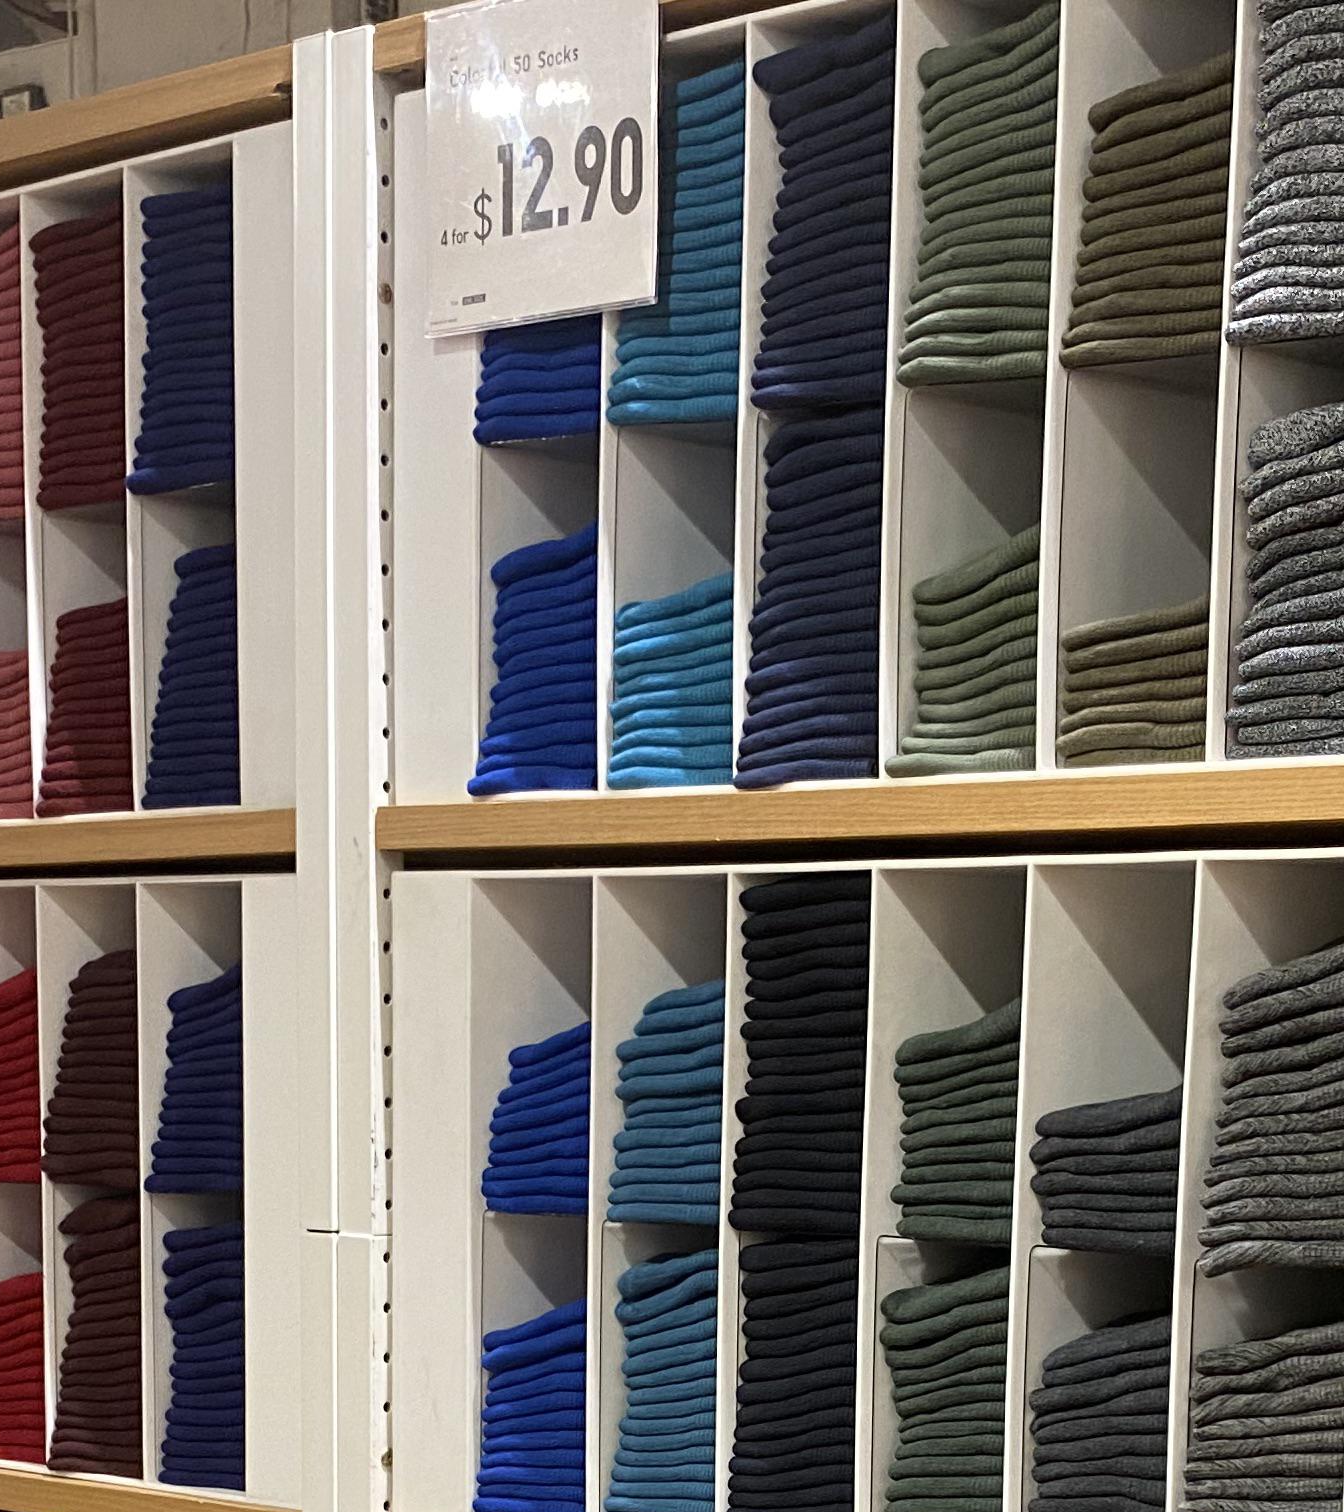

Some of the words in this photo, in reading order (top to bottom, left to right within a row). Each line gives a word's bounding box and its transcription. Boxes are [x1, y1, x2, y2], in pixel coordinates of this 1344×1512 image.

[513, 54, 531, 74] 50
[538, 45, 579, 69] Socks
[441, 229, 448, 247] 4
[451, 228, 469, 246] for
[473, 116, 643, 246] $12.90
